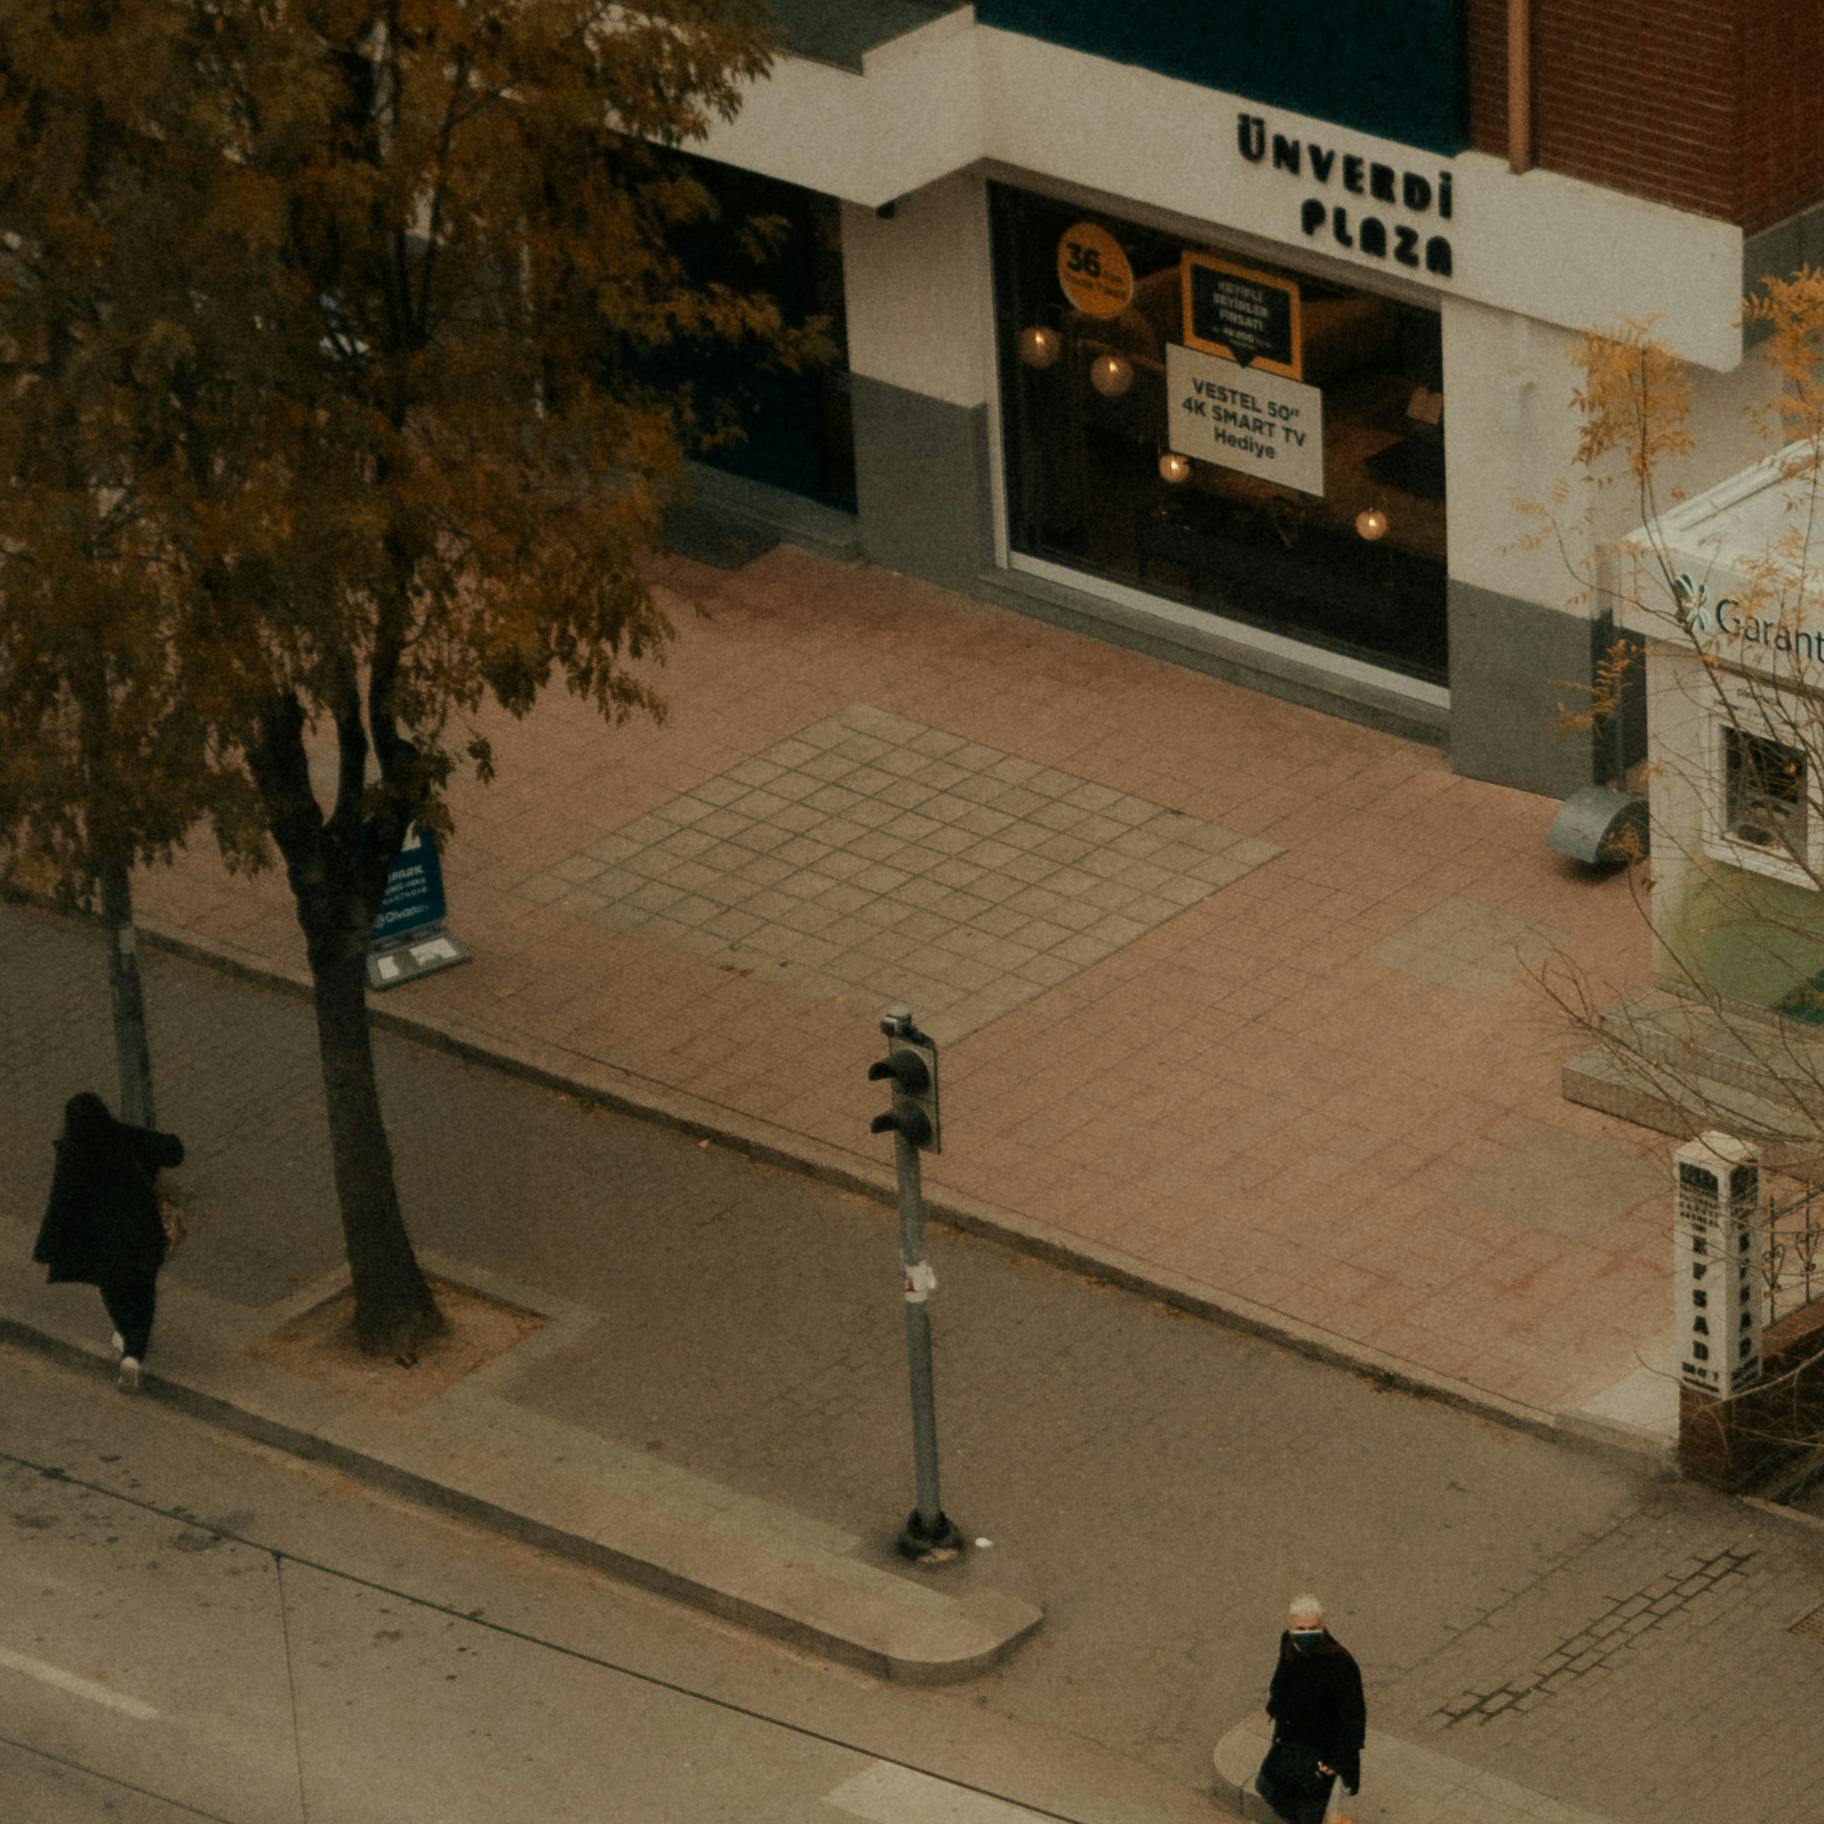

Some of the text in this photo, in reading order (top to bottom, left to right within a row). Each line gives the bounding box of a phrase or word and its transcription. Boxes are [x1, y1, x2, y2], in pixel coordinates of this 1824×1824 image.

[1237, 113, 1452, 220] ÜNVERDİ
[1300, 197, 1453, 277] PLAZA
[1066, 241, 1101, 278] 36
[1192, 377, 1262, 414] VESTEL
[1182, 396, 1307, 447] 4K SMART TV
[1213, 426, 1276, 460] Hediye
